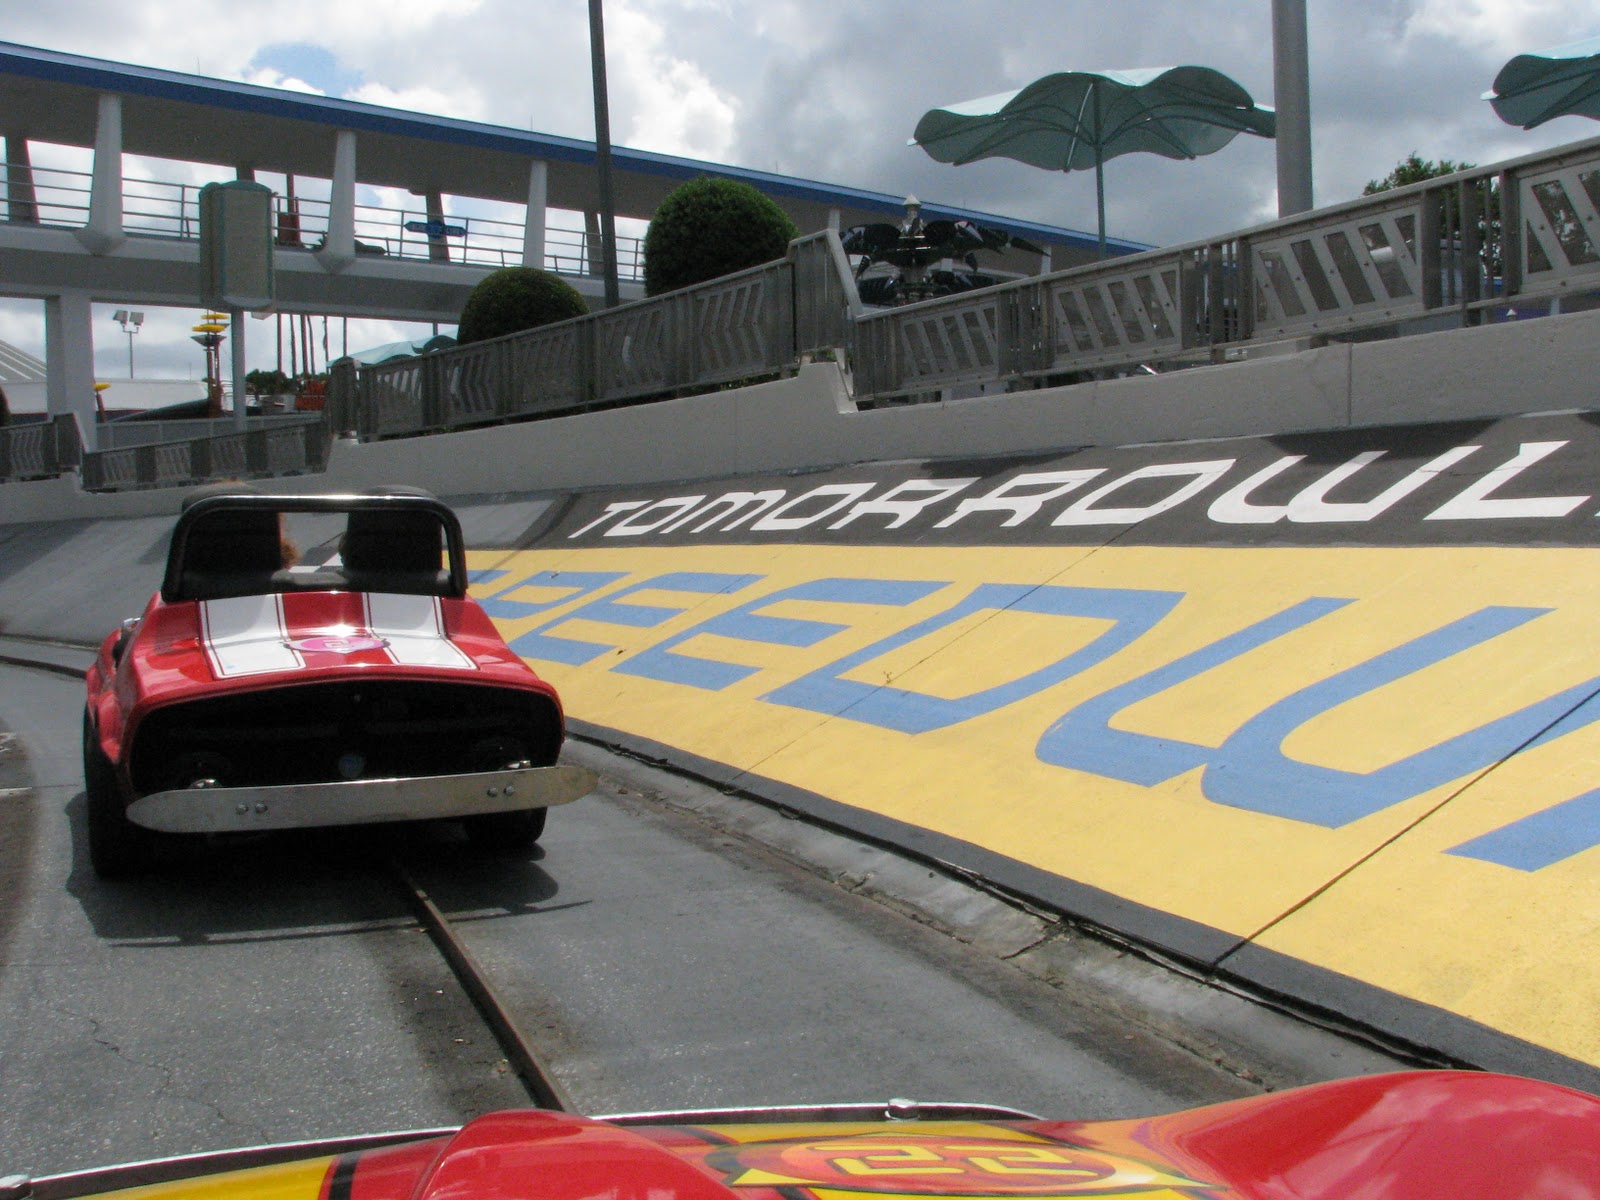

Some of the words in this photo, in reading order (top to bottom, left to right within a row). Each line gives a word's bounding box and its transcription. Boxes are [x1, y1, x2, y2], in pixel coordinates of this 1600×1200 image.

[568, 440, 1600, 538] TOMORROWL
[466, 569, 1600, 872] PEEDW
[807, 1144, 1098, 1176] 22
